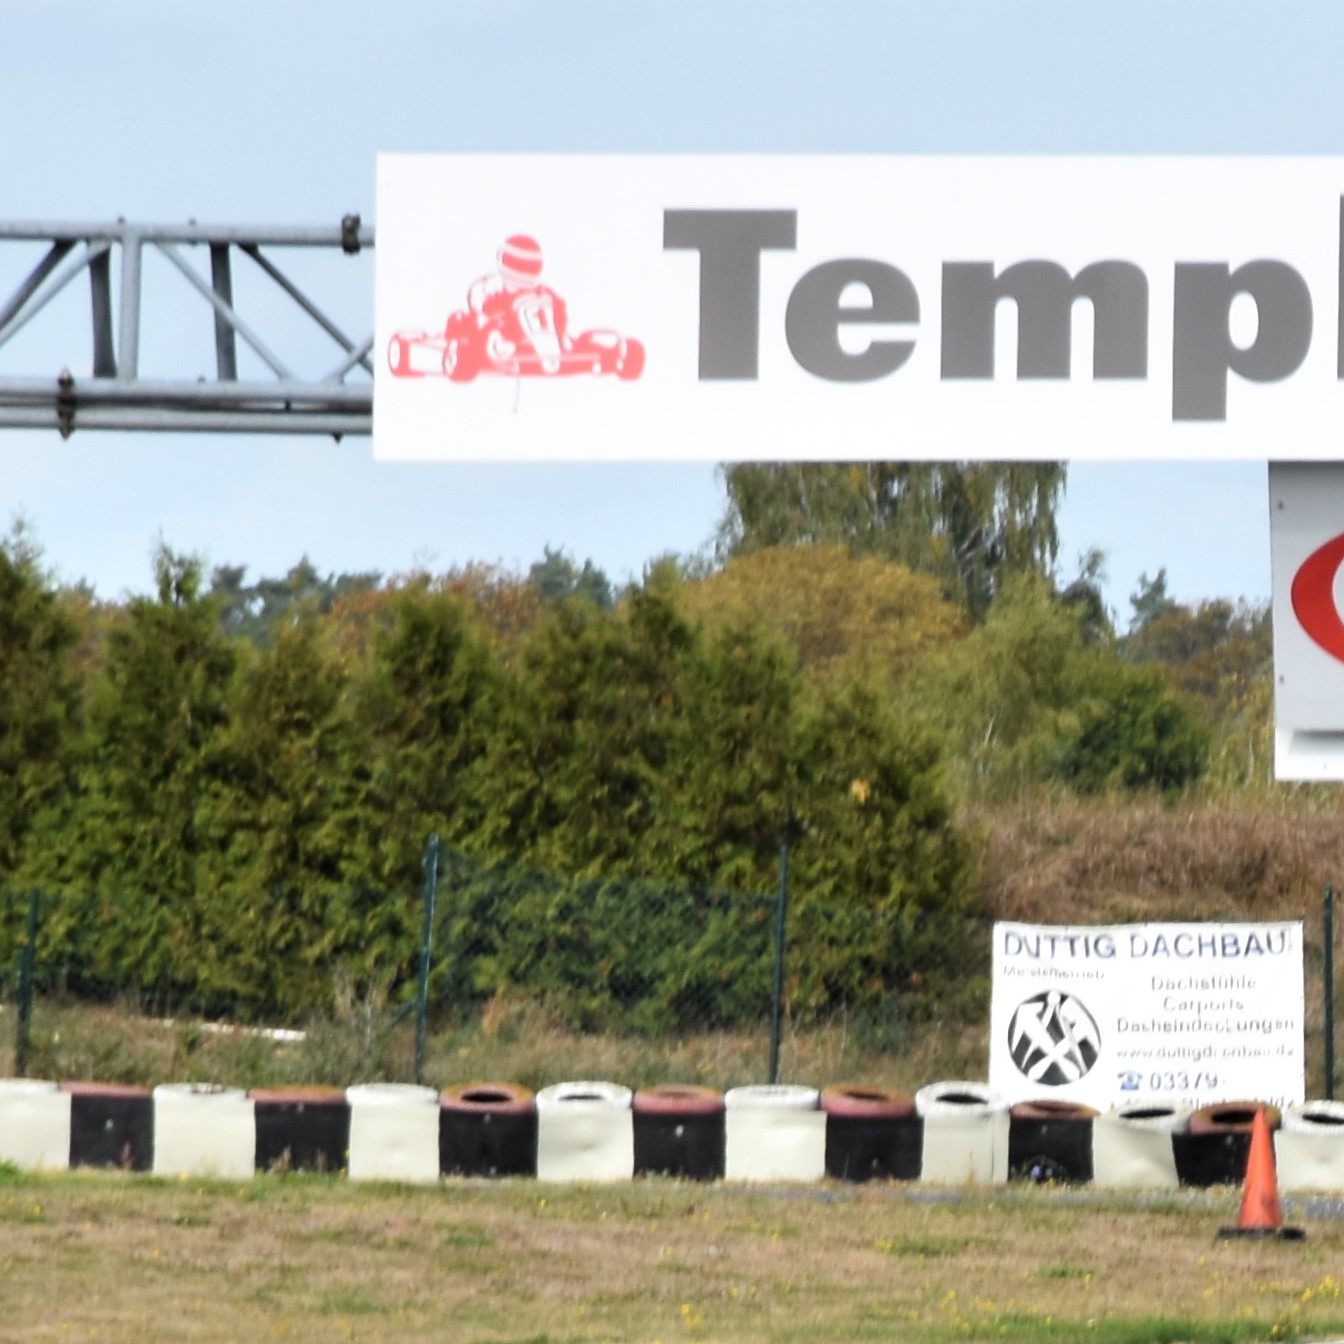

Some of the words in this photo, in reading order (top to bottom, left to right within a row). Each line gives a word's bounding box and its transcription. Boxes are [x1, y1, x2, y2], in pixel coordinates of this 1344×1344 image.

[1004, 931, 1117, 959] DUTTIG
[1130, 929, 1286, 959] DACHBAU
[1163, 996, 1245, 1014] Carports
